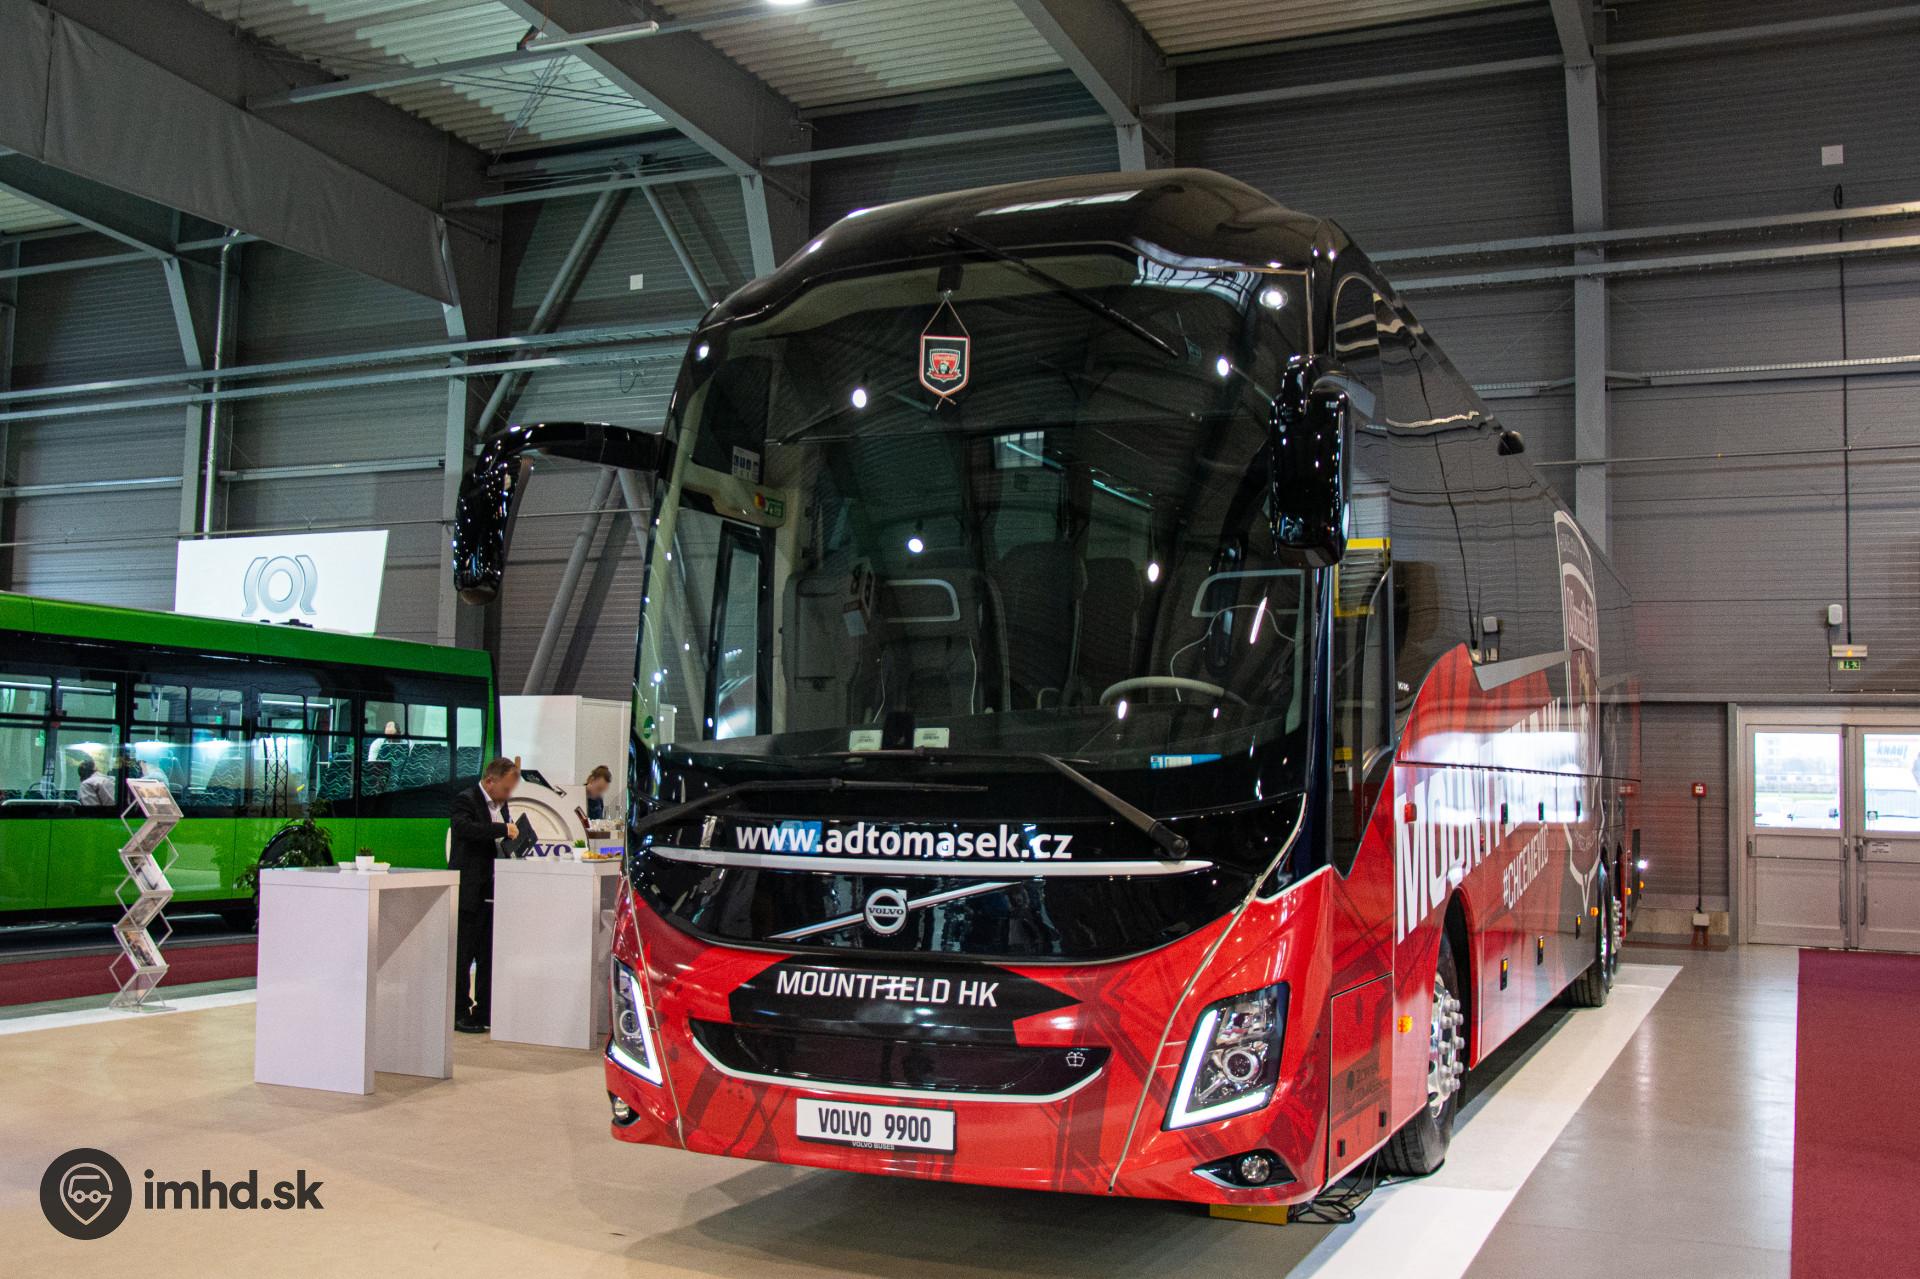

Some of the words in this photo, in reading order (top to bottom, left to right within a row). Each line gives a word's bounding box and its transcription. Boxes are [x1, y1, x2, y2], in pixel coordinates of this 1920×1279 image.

[736, 822, 1073, 859] www.adtomasek.cz
[868, 907, 904, 915] VOLVO
[776, 971, 950, 1004] MOUNTFIELD
[958, 980, 999, 1007] HK
[818, 1107, 871, 1137] VOLVO
[884, 1113, 932, 1142] 9900
